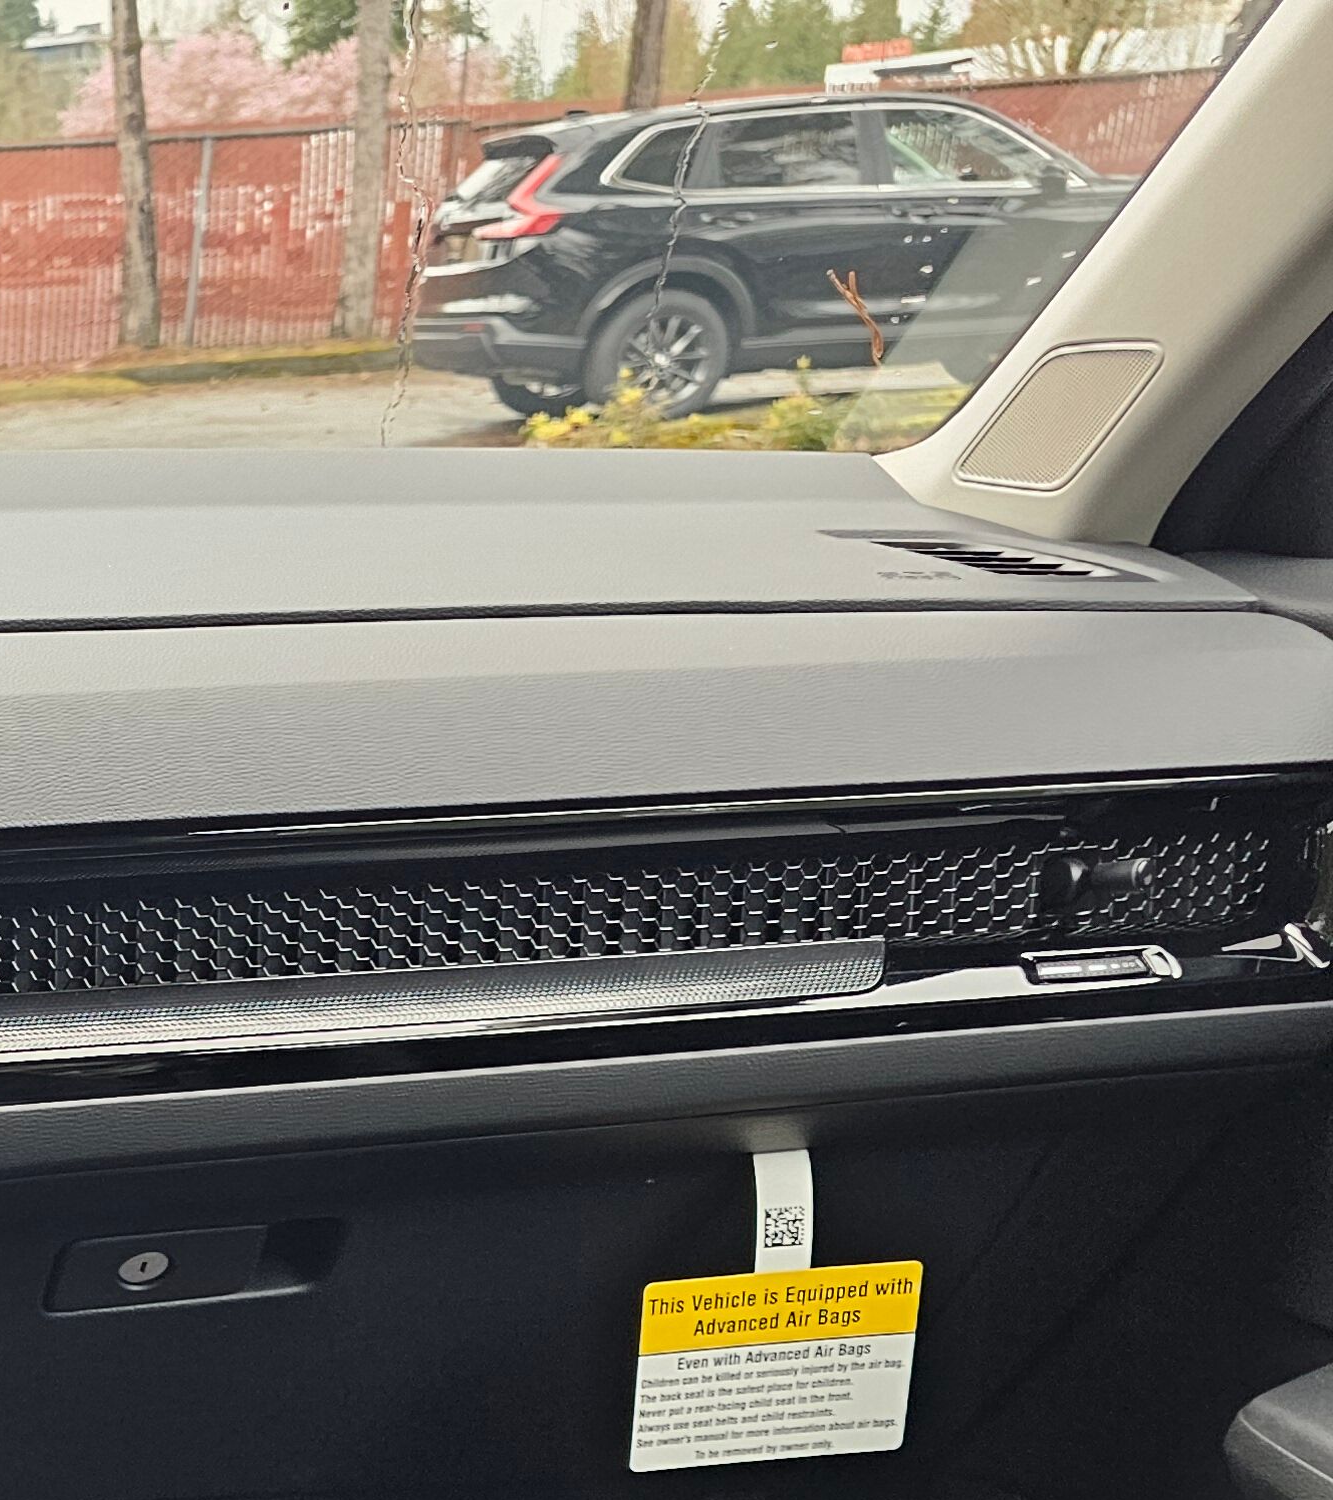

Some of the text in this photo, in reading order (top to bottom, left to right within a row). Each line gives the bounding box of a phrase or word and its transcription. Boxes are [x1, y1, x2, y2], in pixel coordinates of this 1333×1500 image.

[649, 1277, 913, 1317] This Vehicle is Equipped with
[693, 1308, 862, 1337] Advanced Air Bags
[677, 1343, 871, 1370] Even with Advanced Air Bags
